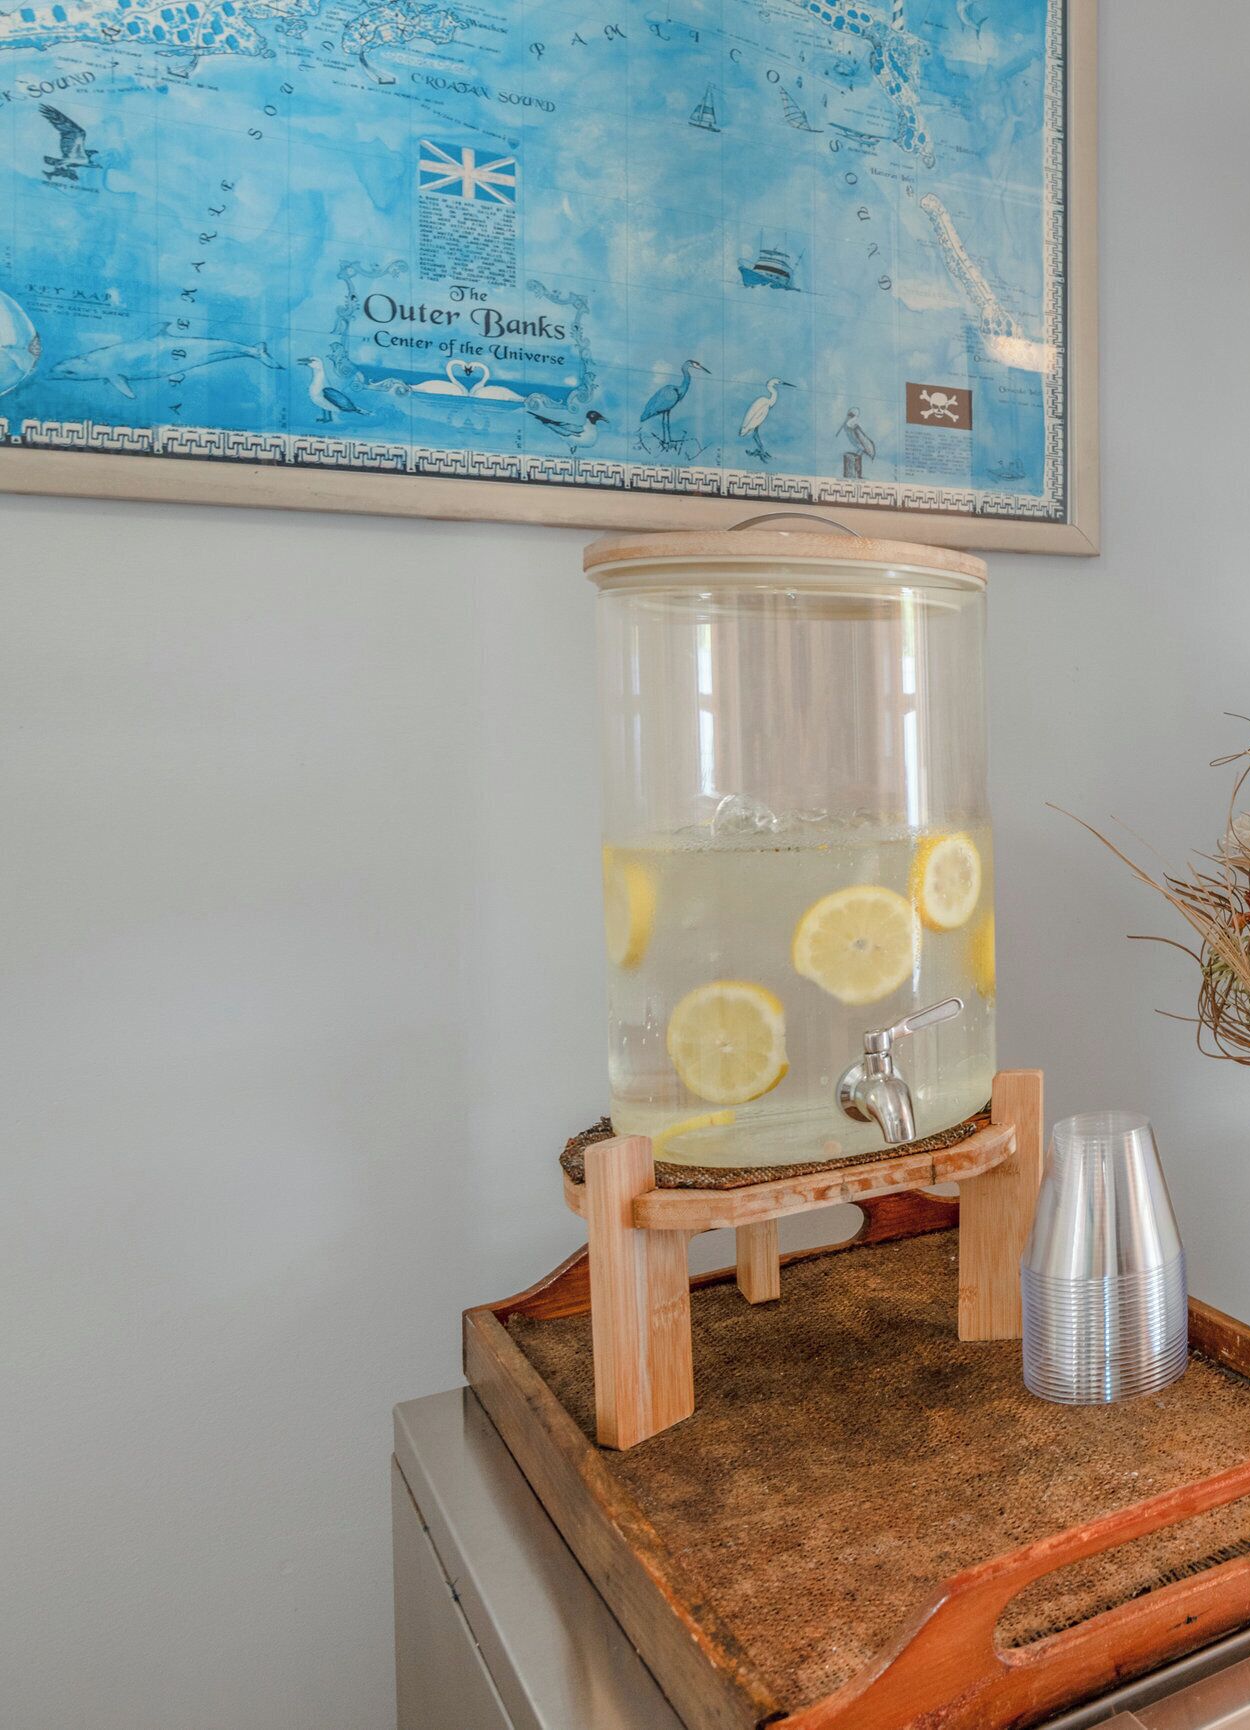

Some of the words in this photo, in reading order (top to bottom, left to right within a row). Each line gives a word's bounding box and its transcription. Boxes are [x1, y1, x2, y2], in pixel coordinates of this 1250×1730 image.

[27, 71, 96, 99] SOUND
[411, 72, 491, 100] CROATAN
[497, 91, 556, 113] SOUND
[449, 285, 488, 302] The
[364, 293, 460, 326] Outer
[470, 308, 566, 340] Banks
[439, 339, 457, 357] of
[460, 341, 484, 356] the
[489, 344, 565, 366] Universe
